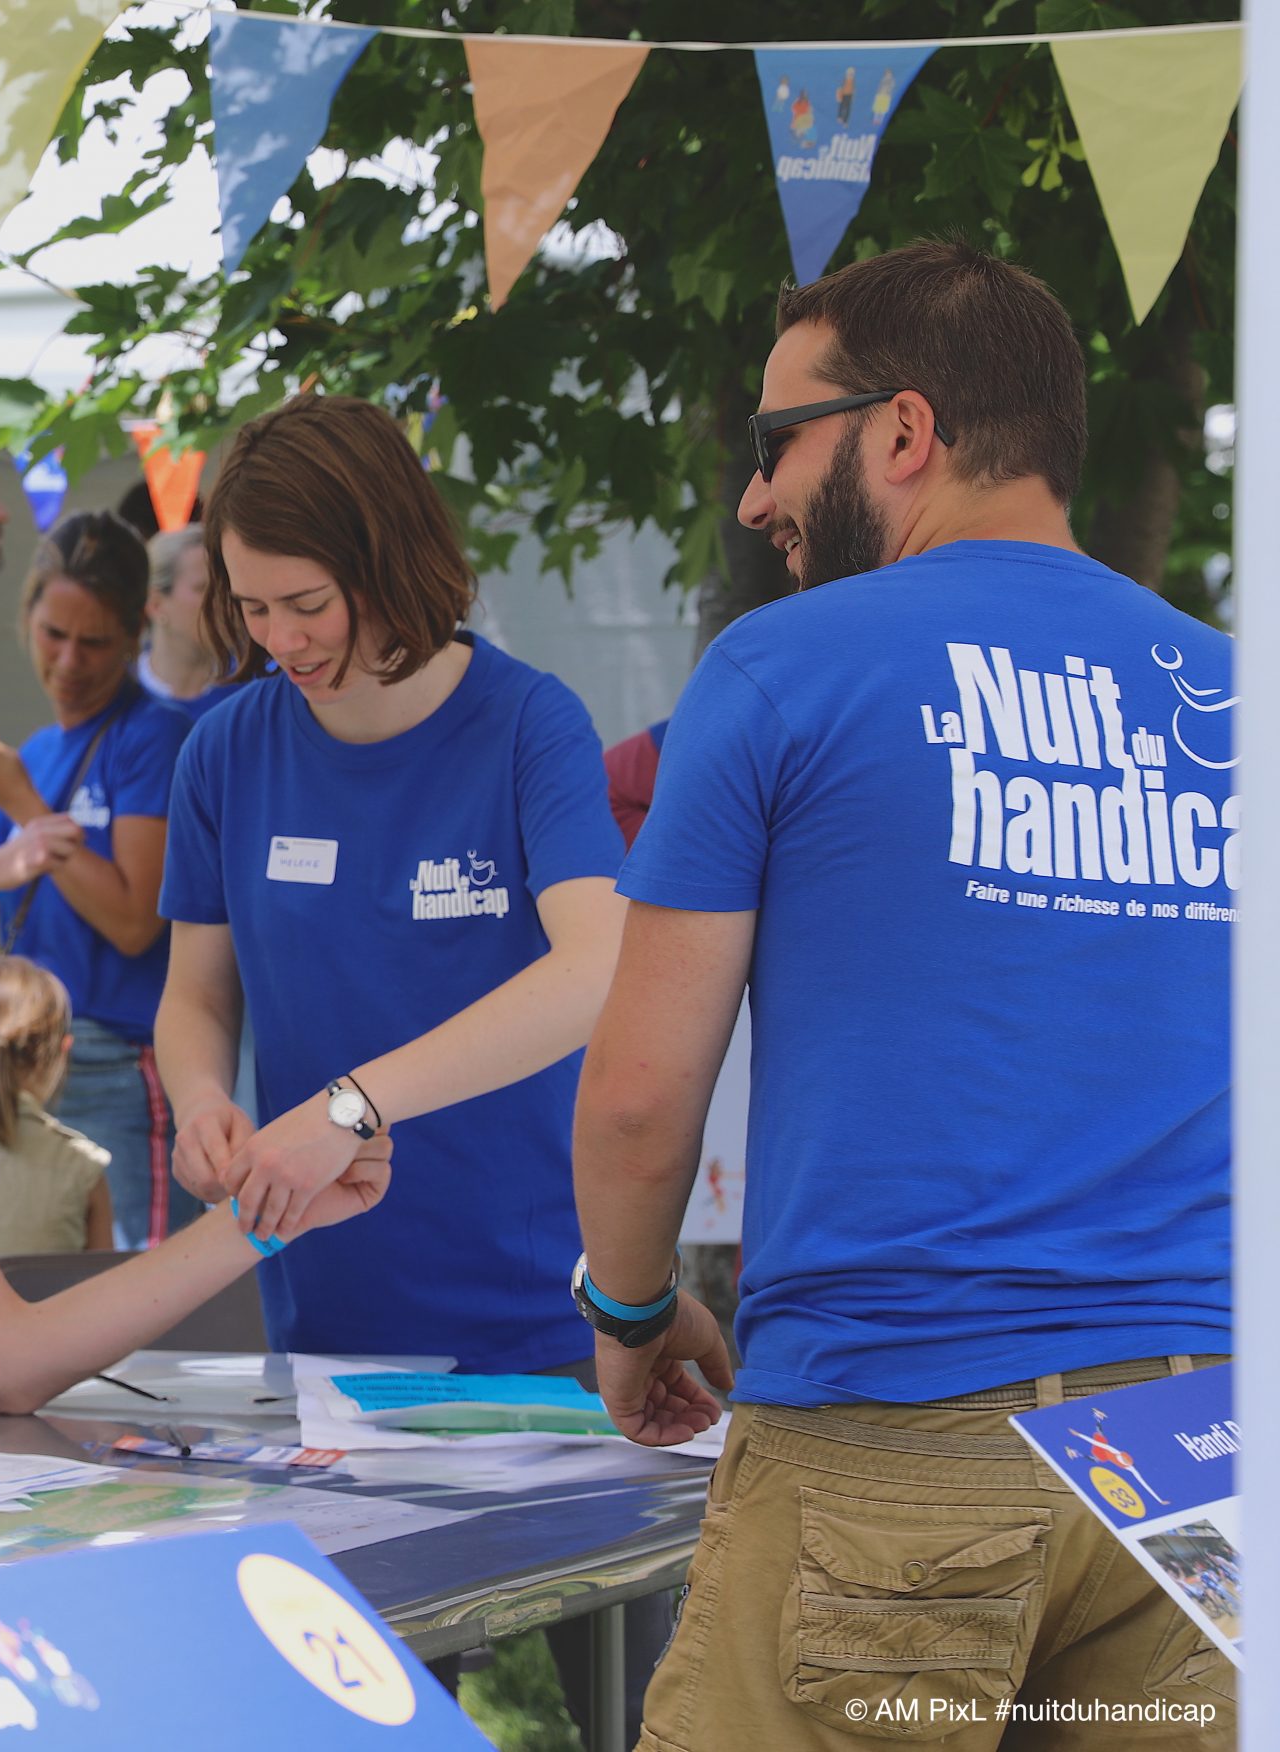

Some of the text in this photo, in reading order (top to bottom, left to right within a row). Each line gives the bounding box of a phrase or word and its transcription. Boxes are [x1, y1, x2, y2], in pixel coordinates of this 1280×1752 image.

[920, 642, 1168, 770] La Nuit du
[417, 857, 461, 892] Nuit
[412, 886, 510, 920] handicap
[965, 879, 1241, 923] Faire une richesse de nos différen
[1173, 1423, 1241, 1462] Handi
[1109, 1487, 1137, 1509] 33
[302, 1626, 385, 1689] 21
